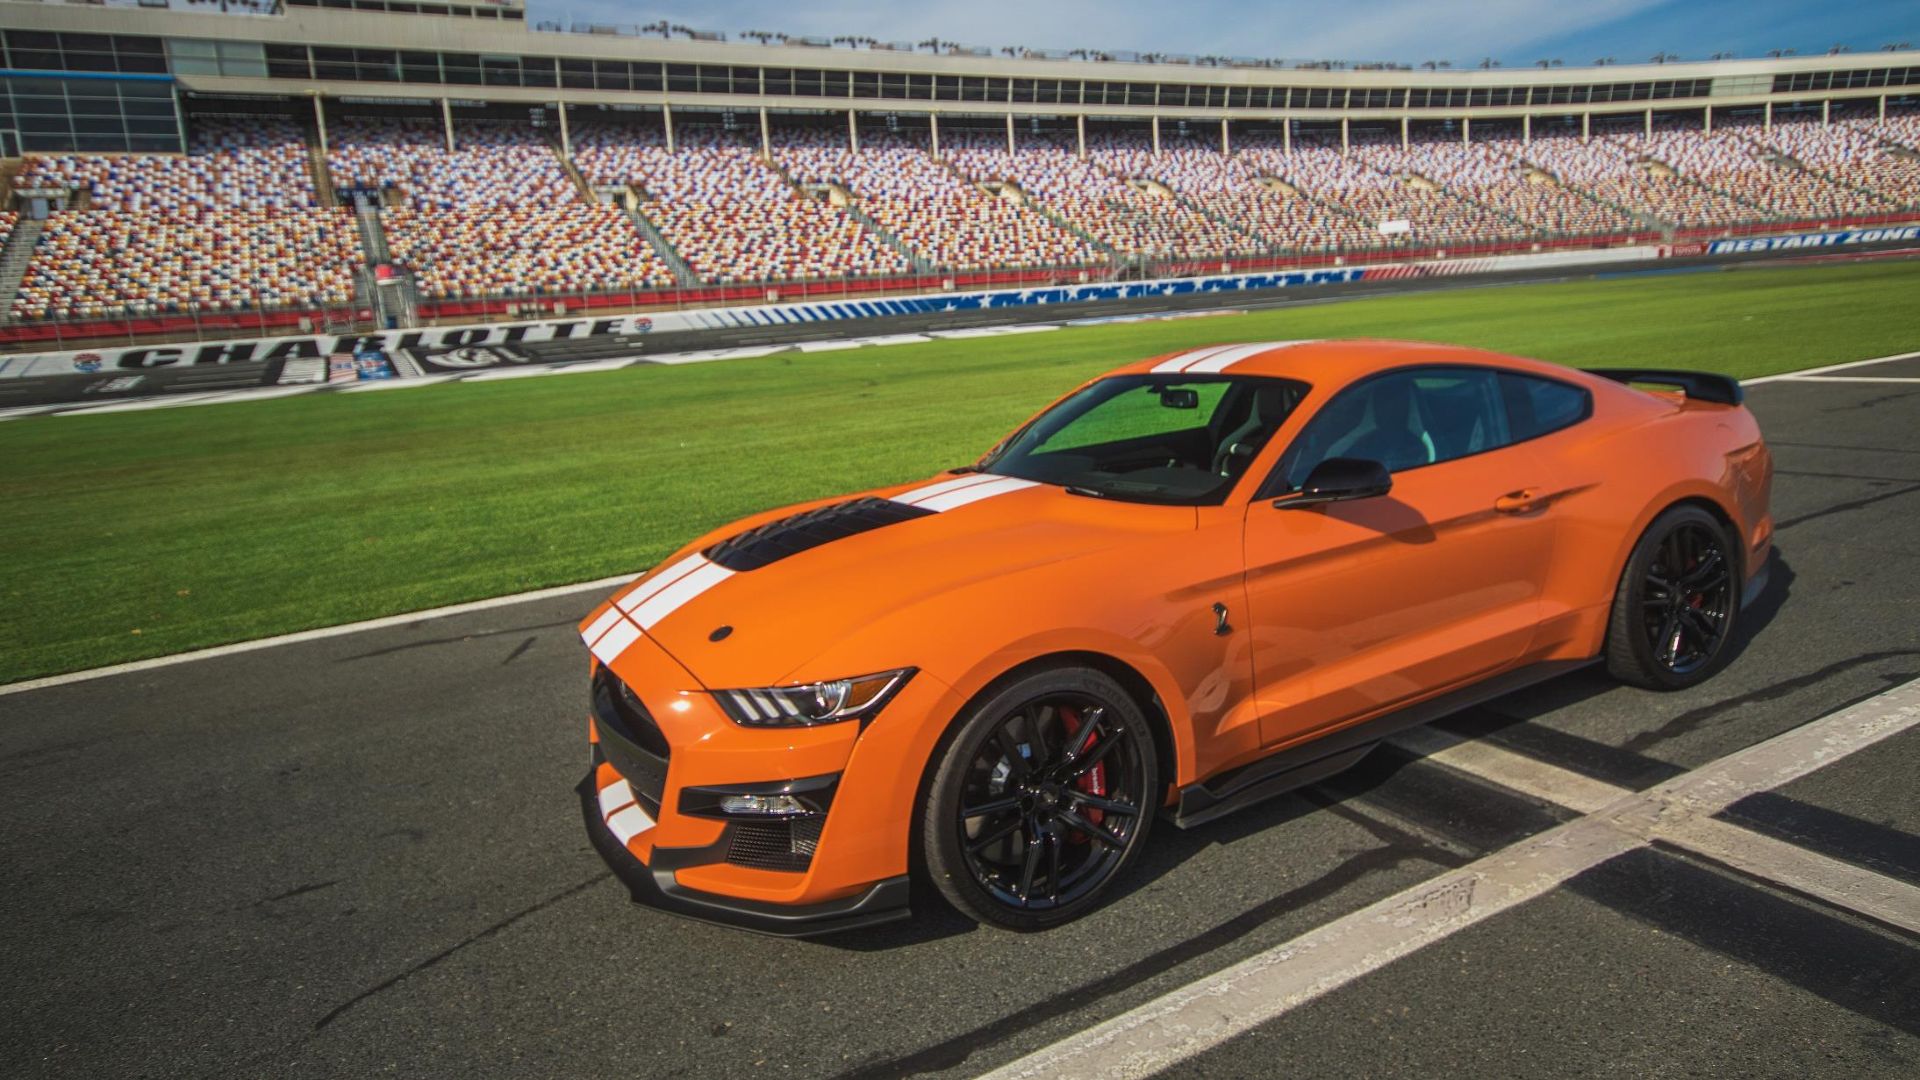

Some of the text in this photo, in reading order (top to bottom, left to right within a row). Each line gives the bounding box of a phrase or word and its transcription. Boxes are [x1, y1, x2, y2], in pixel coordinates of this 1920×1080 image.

[1714, 227, 1919, 255] RESTART ZONE
[116, 318, 626, 368] CHARLOTTE
